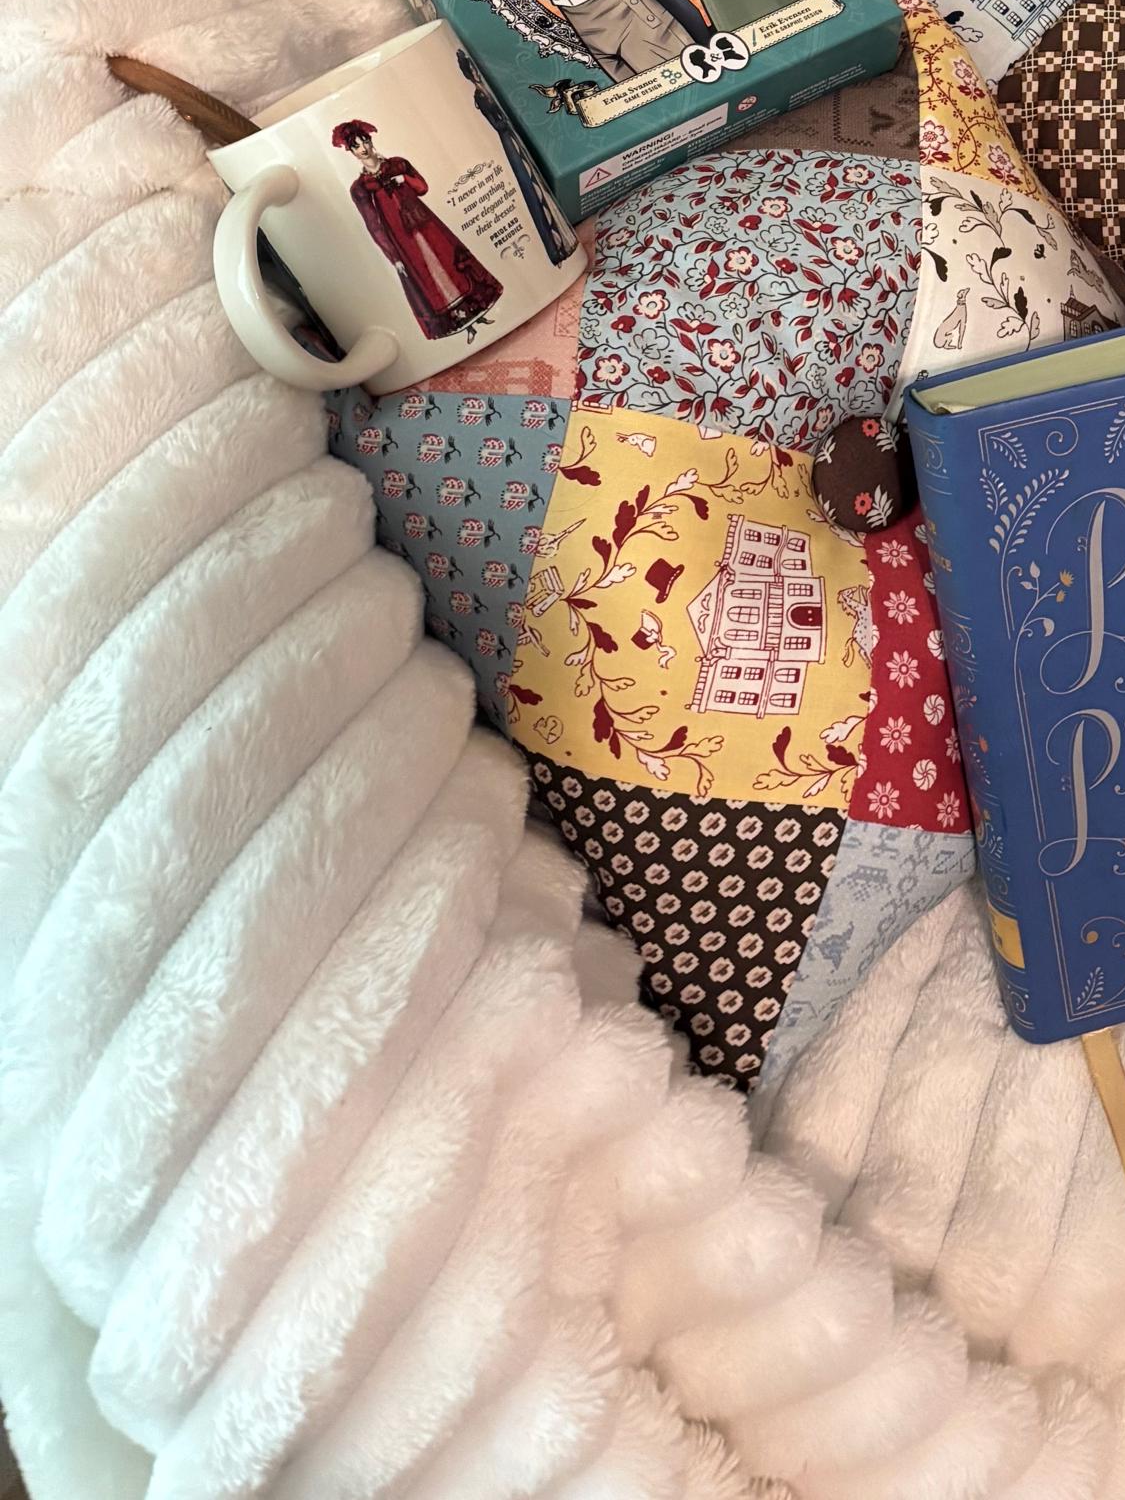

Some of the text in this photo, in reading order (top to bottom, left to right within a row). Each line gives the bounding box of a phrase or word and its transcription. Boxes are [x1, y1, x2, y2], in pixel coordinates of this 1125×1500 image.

[758, 5, 812, 34] Erik Evensen
[763, 30, 774, 40] ART
[780, 17, 804, 32] GRAPHIC
[801, 8, 823, 22] DESIGN
[709, 51, 723, 63] &
[602, 89, 629, 106] Erika
[623, 82, 664, 104] GAME DESIGN
[621, 132, 675, 161] WARNING!
[457, 184, 477, 203] never
[477, 180, 485, 190] in
[485, 172, 495, 184] my
[463, 181, 505, 214] saw anything
[461, 214, 480, 231] more
[480, 196, 503, 218] elegant
[476, 220, 493, 236] their
[489, 216, 519, 242] PRIDE AND
[493, 223, 524, 248] PREJUDICE
